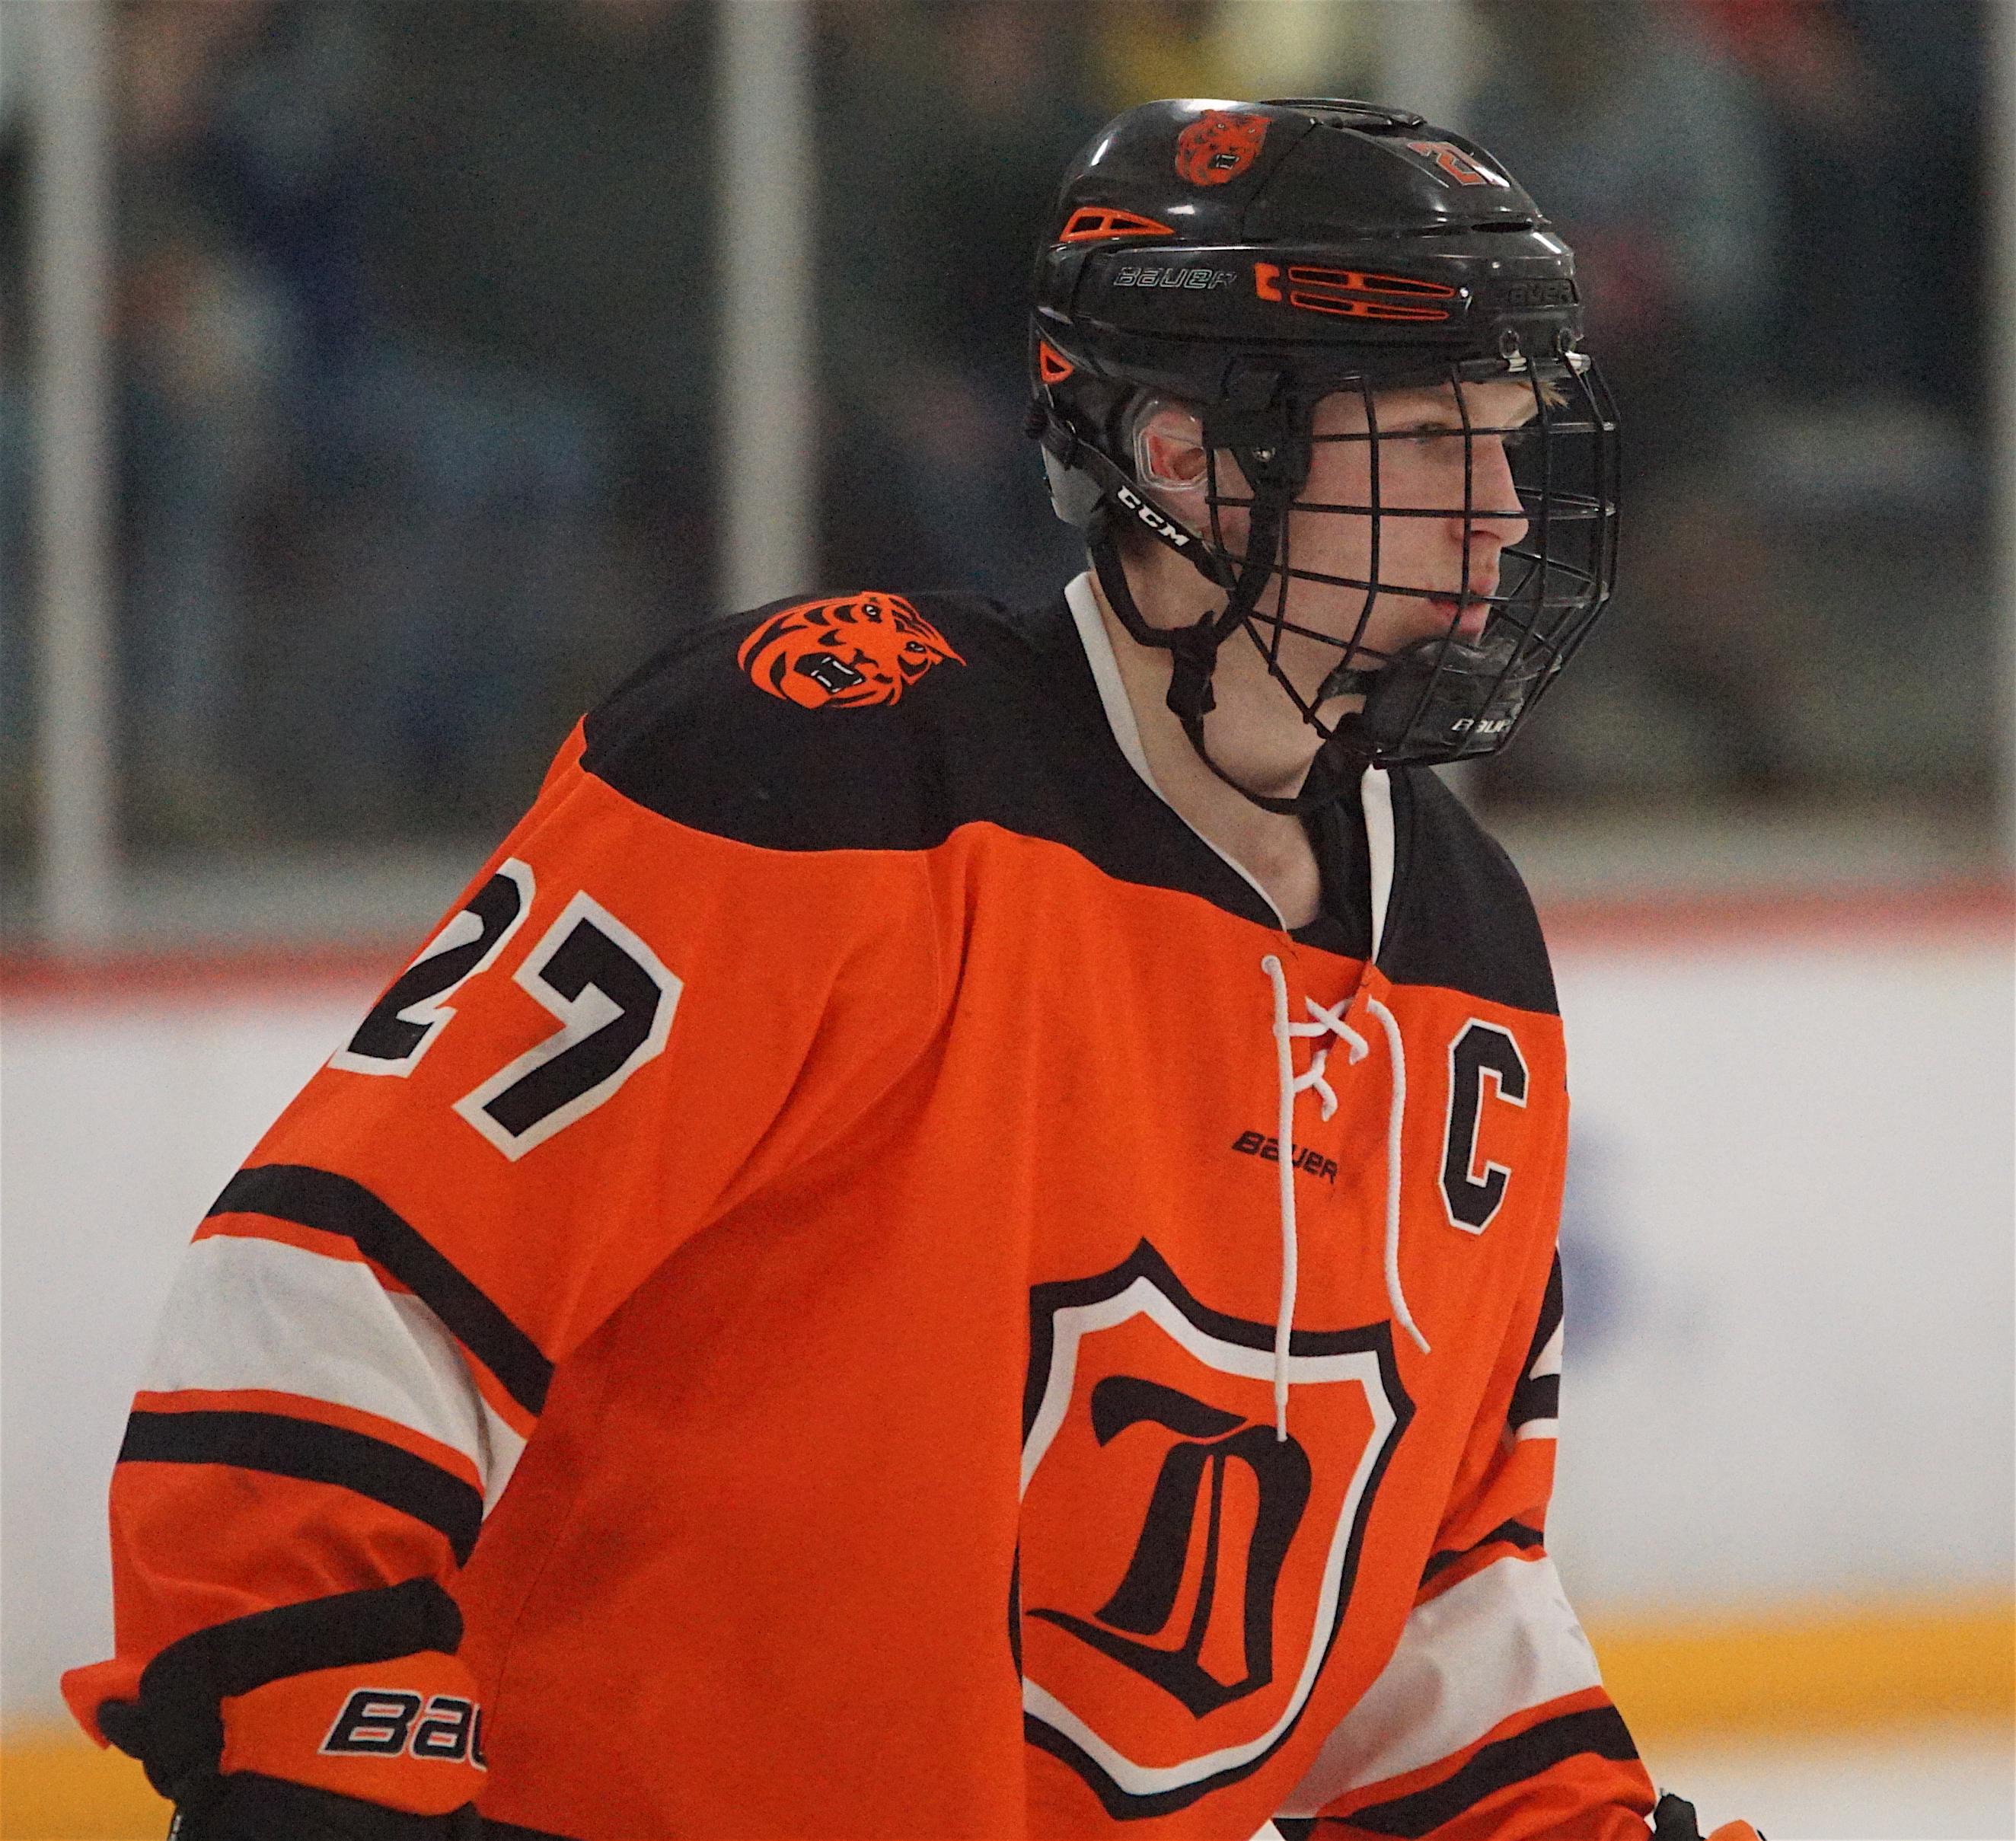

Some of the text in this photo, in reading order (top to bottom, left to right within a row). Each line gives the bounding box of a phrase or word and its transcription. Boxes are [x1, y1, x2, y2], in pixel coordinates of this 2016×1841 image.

[1117, 485, 1190, 547] CCM
[326, 857, 684, 1163] 27
[1438, 1017, 1530, 1235] C
